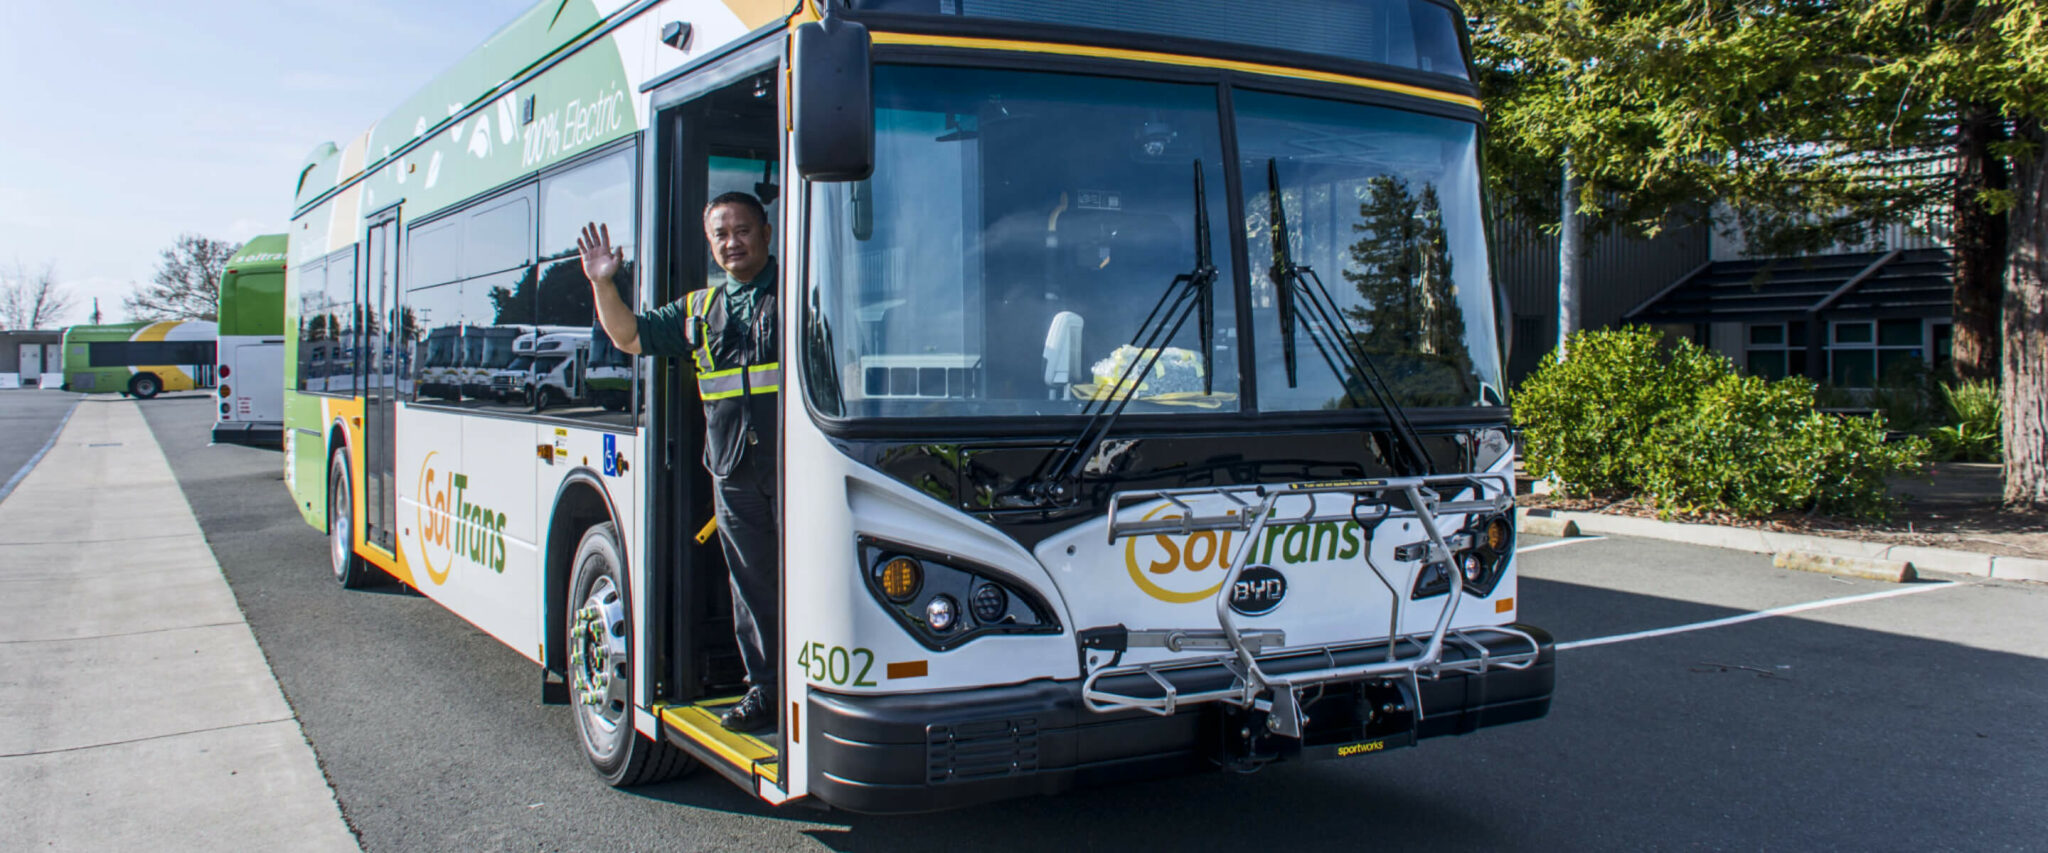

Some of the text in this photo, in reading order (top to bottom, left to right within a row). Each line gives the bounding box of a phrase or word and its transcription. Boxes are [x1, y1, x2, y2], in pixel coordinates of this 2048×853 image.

[522, 80, 624, 168] 100% Electric
[424, 467, 507, 575] SolTrans
[1233, 578, 1283, 602] BYD
[797, 640, 877, 687] 4502
[1338, 740, 1384, 757] sportworks
